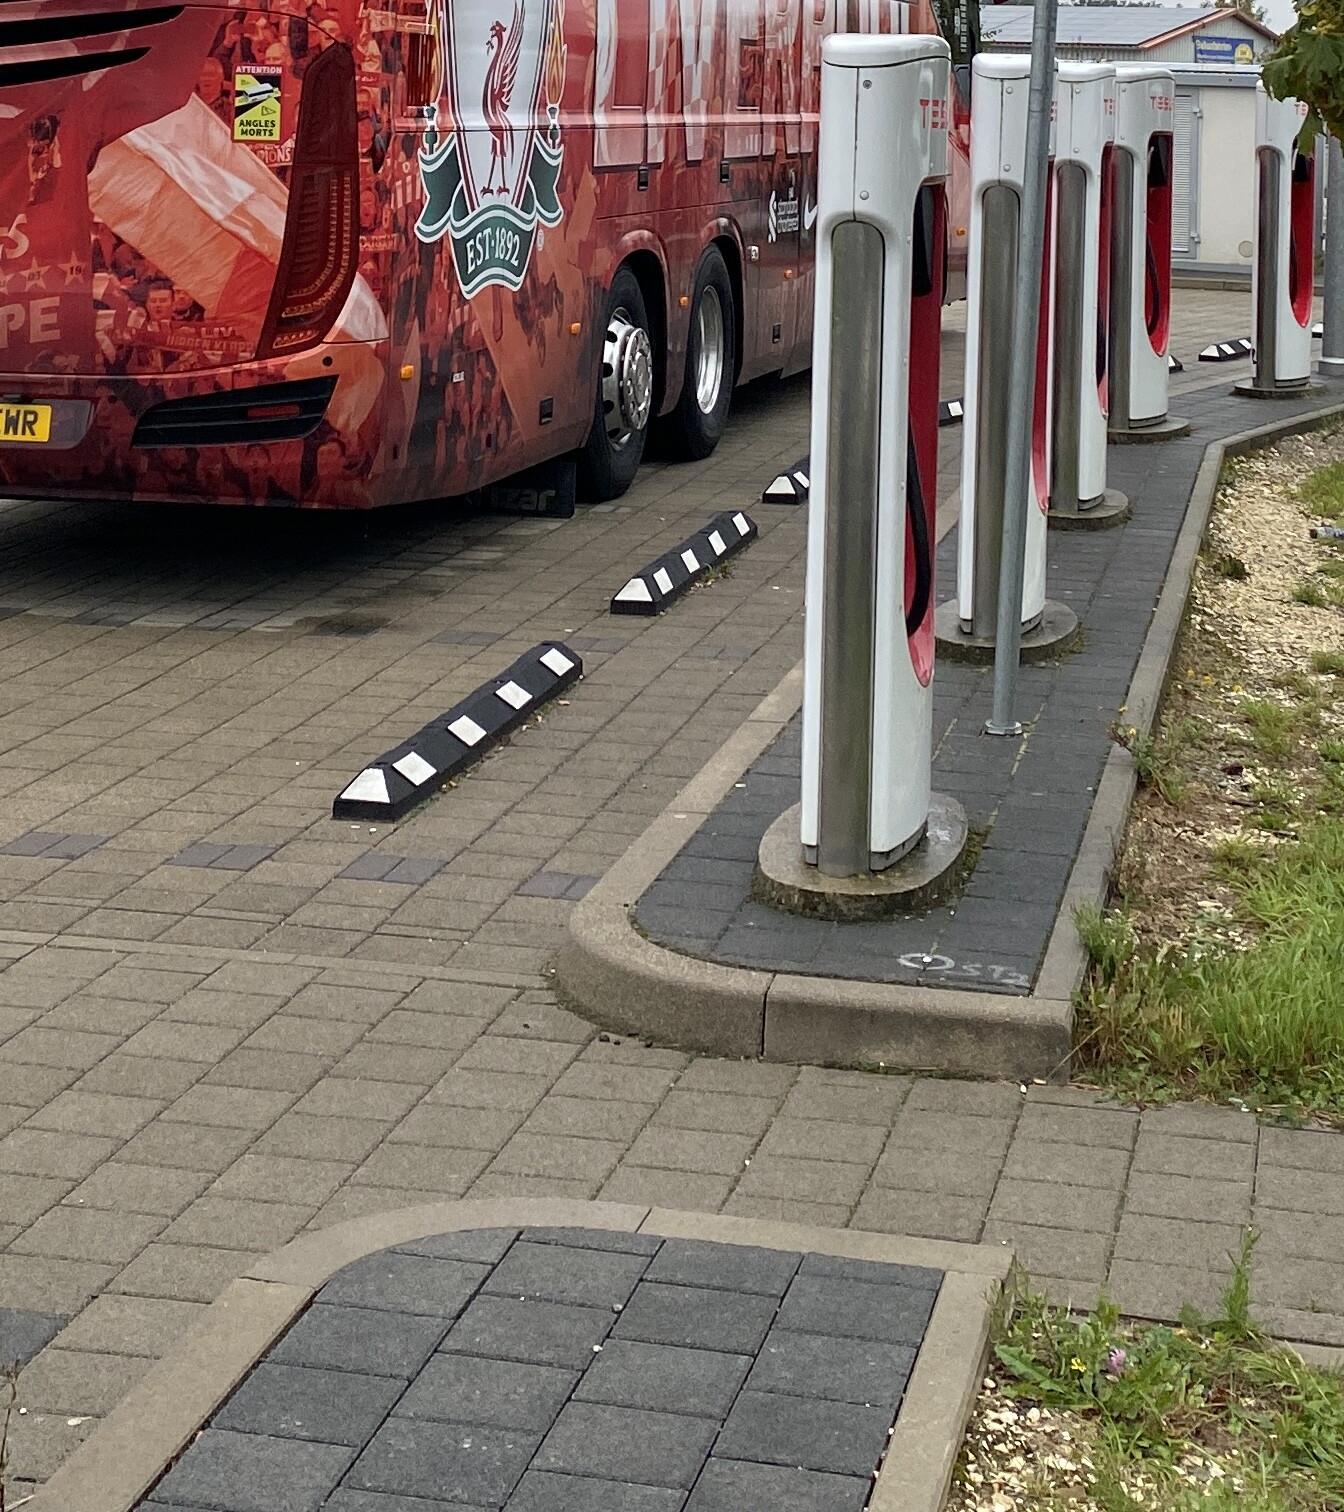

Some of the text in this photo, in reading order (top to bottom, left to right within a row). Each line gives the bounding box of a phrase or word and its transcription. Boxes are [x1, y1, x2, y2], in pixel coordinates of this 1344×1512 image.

[236, 65, 283, 74] ATTENTION
[239, 119, 276, 128] ANGLES
[240, 128, 274, 137] MORTS
